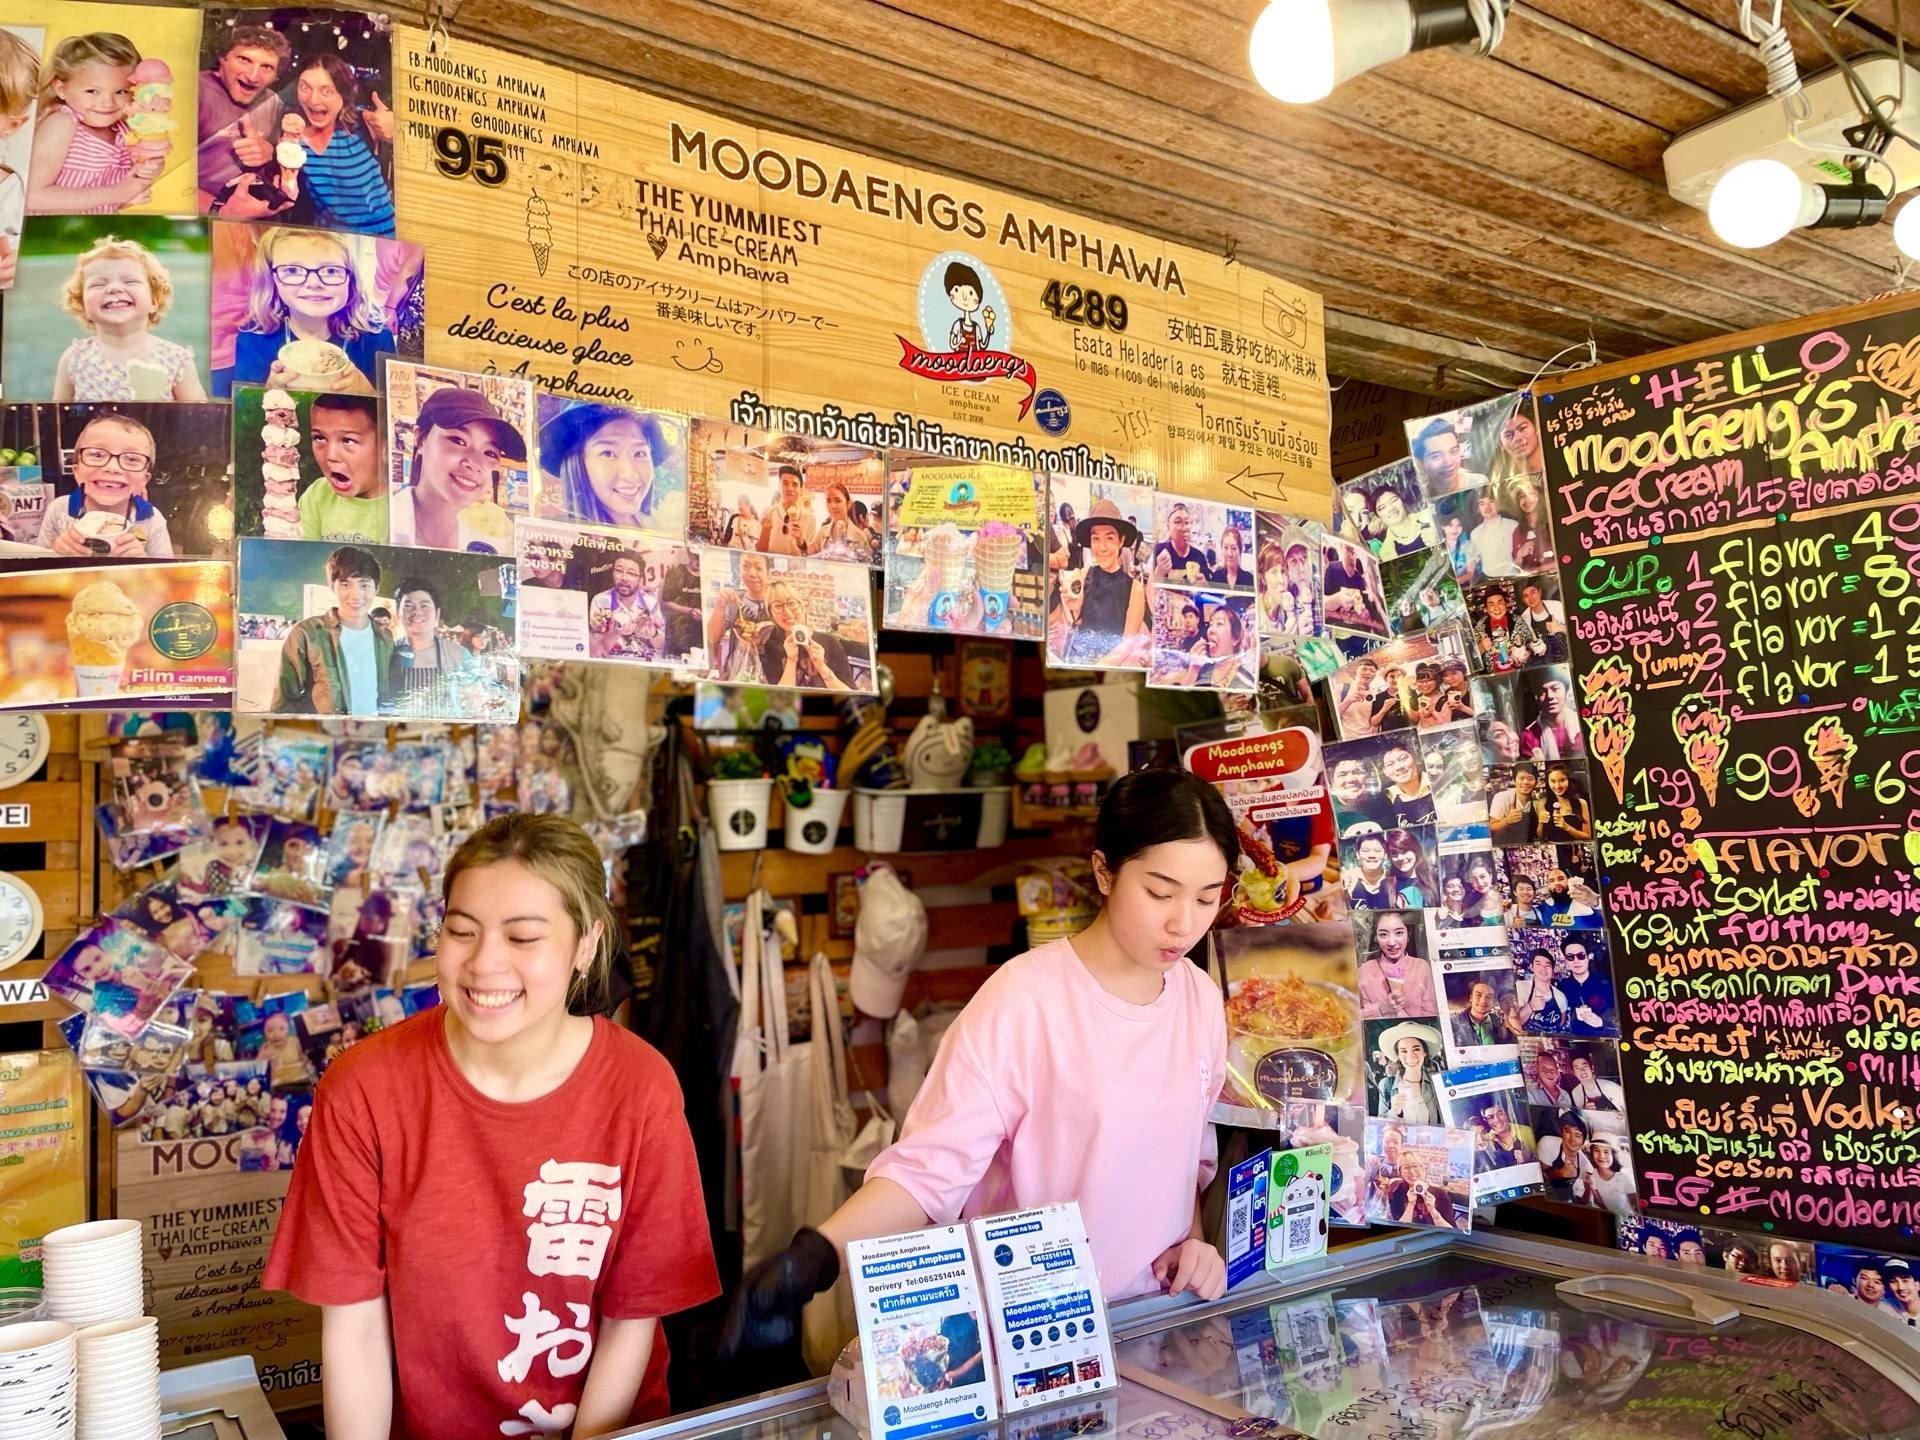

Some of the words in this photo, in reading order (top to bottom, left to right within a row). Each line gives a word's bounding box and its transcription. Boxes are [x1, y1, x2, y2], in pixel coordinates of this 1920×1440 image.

[497, 75, 546, 101] AMPHAWA
[497, 97, 546, 123] AMPHAWA
[471, 112, 543, 144] @MOODAENGS
[552, 134, 599, 159] AMPHAWA
[435, 126, 508, 188] 95
[634, 179, 685, 213] THE
[689, 192, 822, 246] YUMMIEST
[670, 122, 987, 239] MOODAENGS
[999, 212, 1186, 296] AMPHAWA
[677, 241, 790, 285] Amphawa
[552, 296, 577, 322] la
[580, 305, 630, 332] plus
[1040, 278, 1128, 333] 4289
[448, 314, 568, 355] délicieuse
[572, 338, 634, 366] glace
[911, 345, 1028, 379] moodaengs
[1073, 328, 1112, 358] Esata
[1120, 339, 1183, 376] Heladería
[1191, 365, 1205, 380] es
[1091, 363, 1109, 376] mas
[1115, 367, 1142, 384] ricos
[1147, 373, 1162, 390] del
[1646, 331, 1850, 408] HELLO
[941, 385, 959, 397] ICE
[963, 389, 1000, 404] CREAM
[1117, 409, 1152, 440] YES!
[131, 668, 175, 683] Film
[178, 675, 227, 684] camera
[18, 716, 30, 727] 2
[24, 733, 36, 744] 3
[1208, 738, 1284, 760] Moodaengs
[18, 748, 30, 761] 4
[5, 762, 17, 774] 5
[1216, 757, 1285, 777] Amphawa
[151, 1211, 185, 1229] THE
[151, 1230, 184, 1247] THAI
[987, 1228, 1009, 1238] Follow
[180, 1236, 263, 1257] Amphawa
[862, 1250, 898, 1261] Moodaengs
[899, 1244, 931, 1254] Amphawa
[230, 1262, 244, 1275] la
[865, 1259, 917, 1275] Moodaengs
[919, 1251, 962, 1267] Amphawa
[868, 1281, 902, 1293] Derivery
[1008, 1305, 1091, 1329] Moodaengs_amphawa
[903, 1400, 943, 1414] Moodaengs
[944, 1392, 977, 1405] Amphawa
